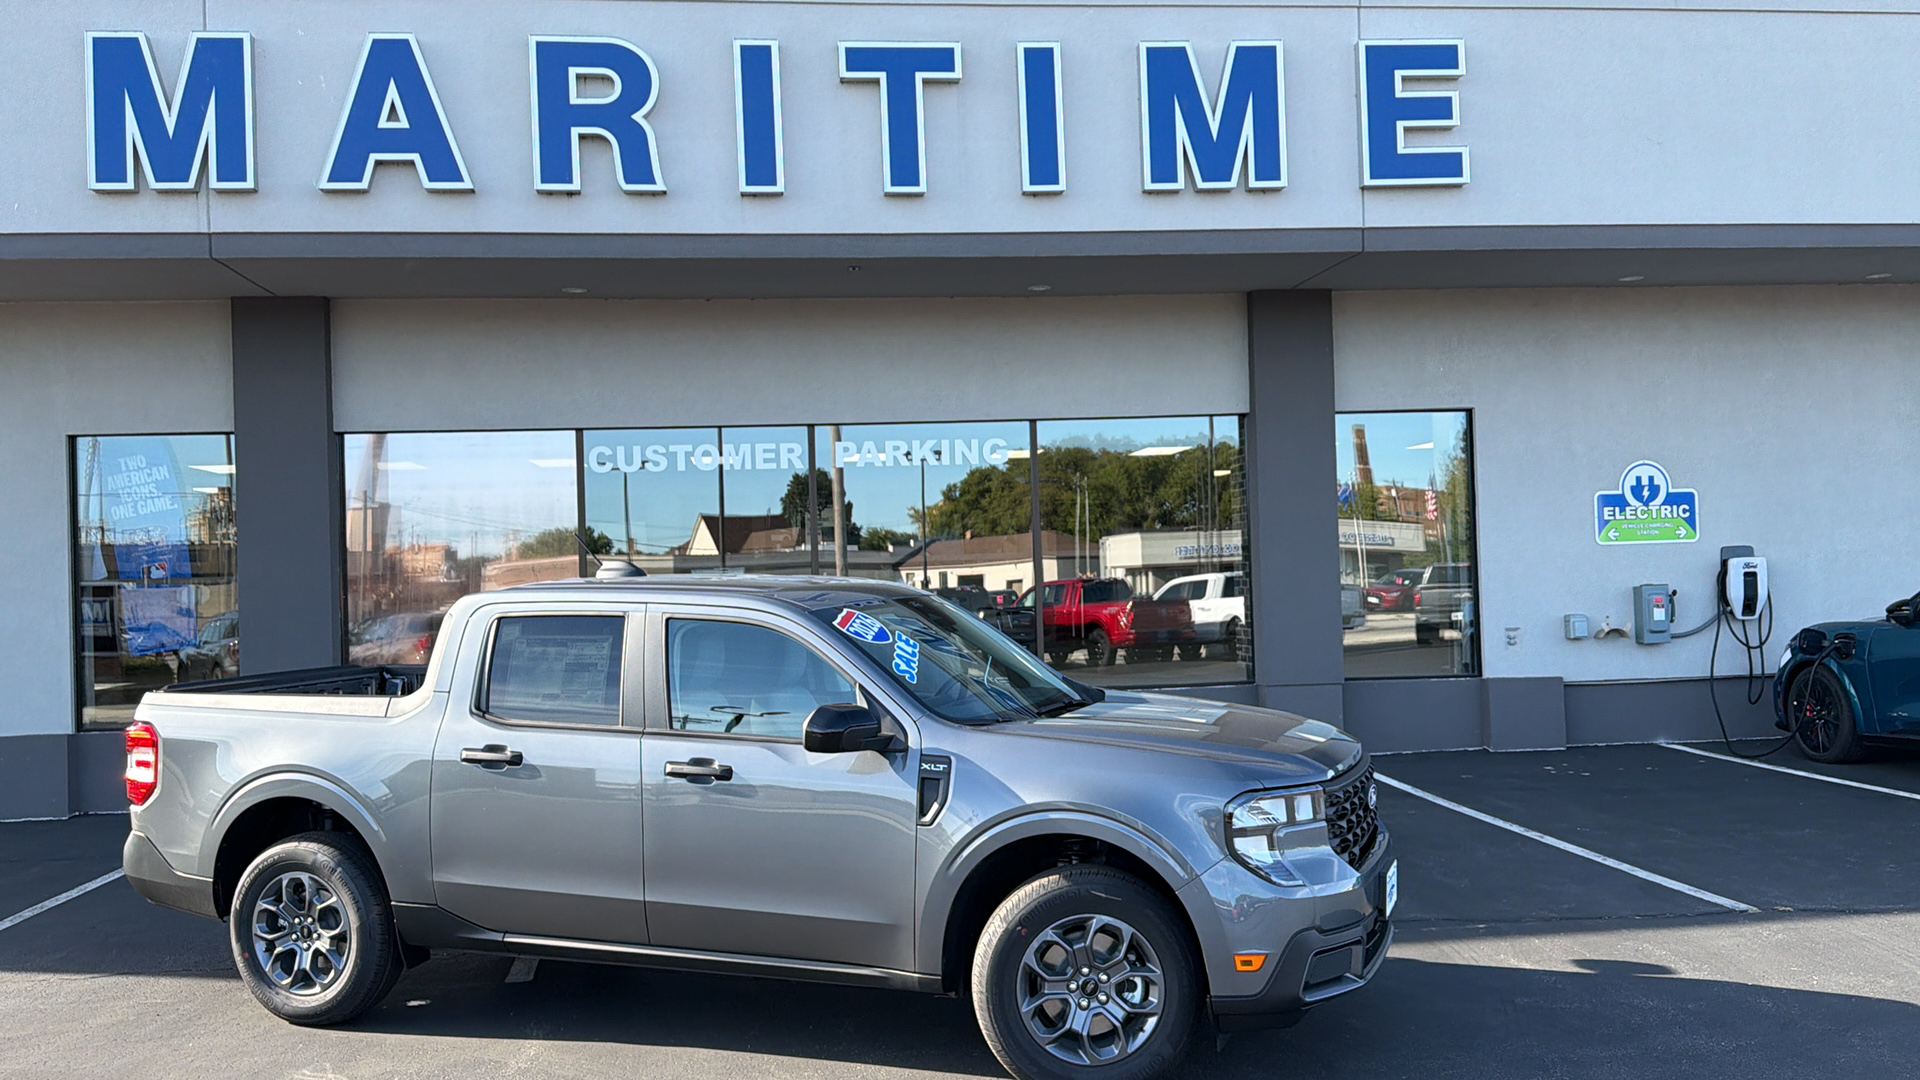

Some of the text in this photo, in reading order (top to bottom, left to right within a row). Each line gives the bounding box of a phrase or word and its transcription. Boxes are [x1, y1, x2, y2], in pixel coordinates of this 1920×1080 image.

[84, 30, 1471, 196] MARITIME
[117, 454, 147, 471] TWO
[588, 437, 1009, 473] CUSTOMER PARKING
[107, 464, 170, 491] AMERICAN
[118, 483, 163, 503] ICONS.
[110, 496, 179, 521] ONE GAME.
[1603, 504, 1691, 521] ELECTRIC
[1742, 561, 1759, 570] Ford
[848, 613, 882, 641] 2026
[892, 630, 920, 685] SALE
[920, 762, 948, 771] XLT
